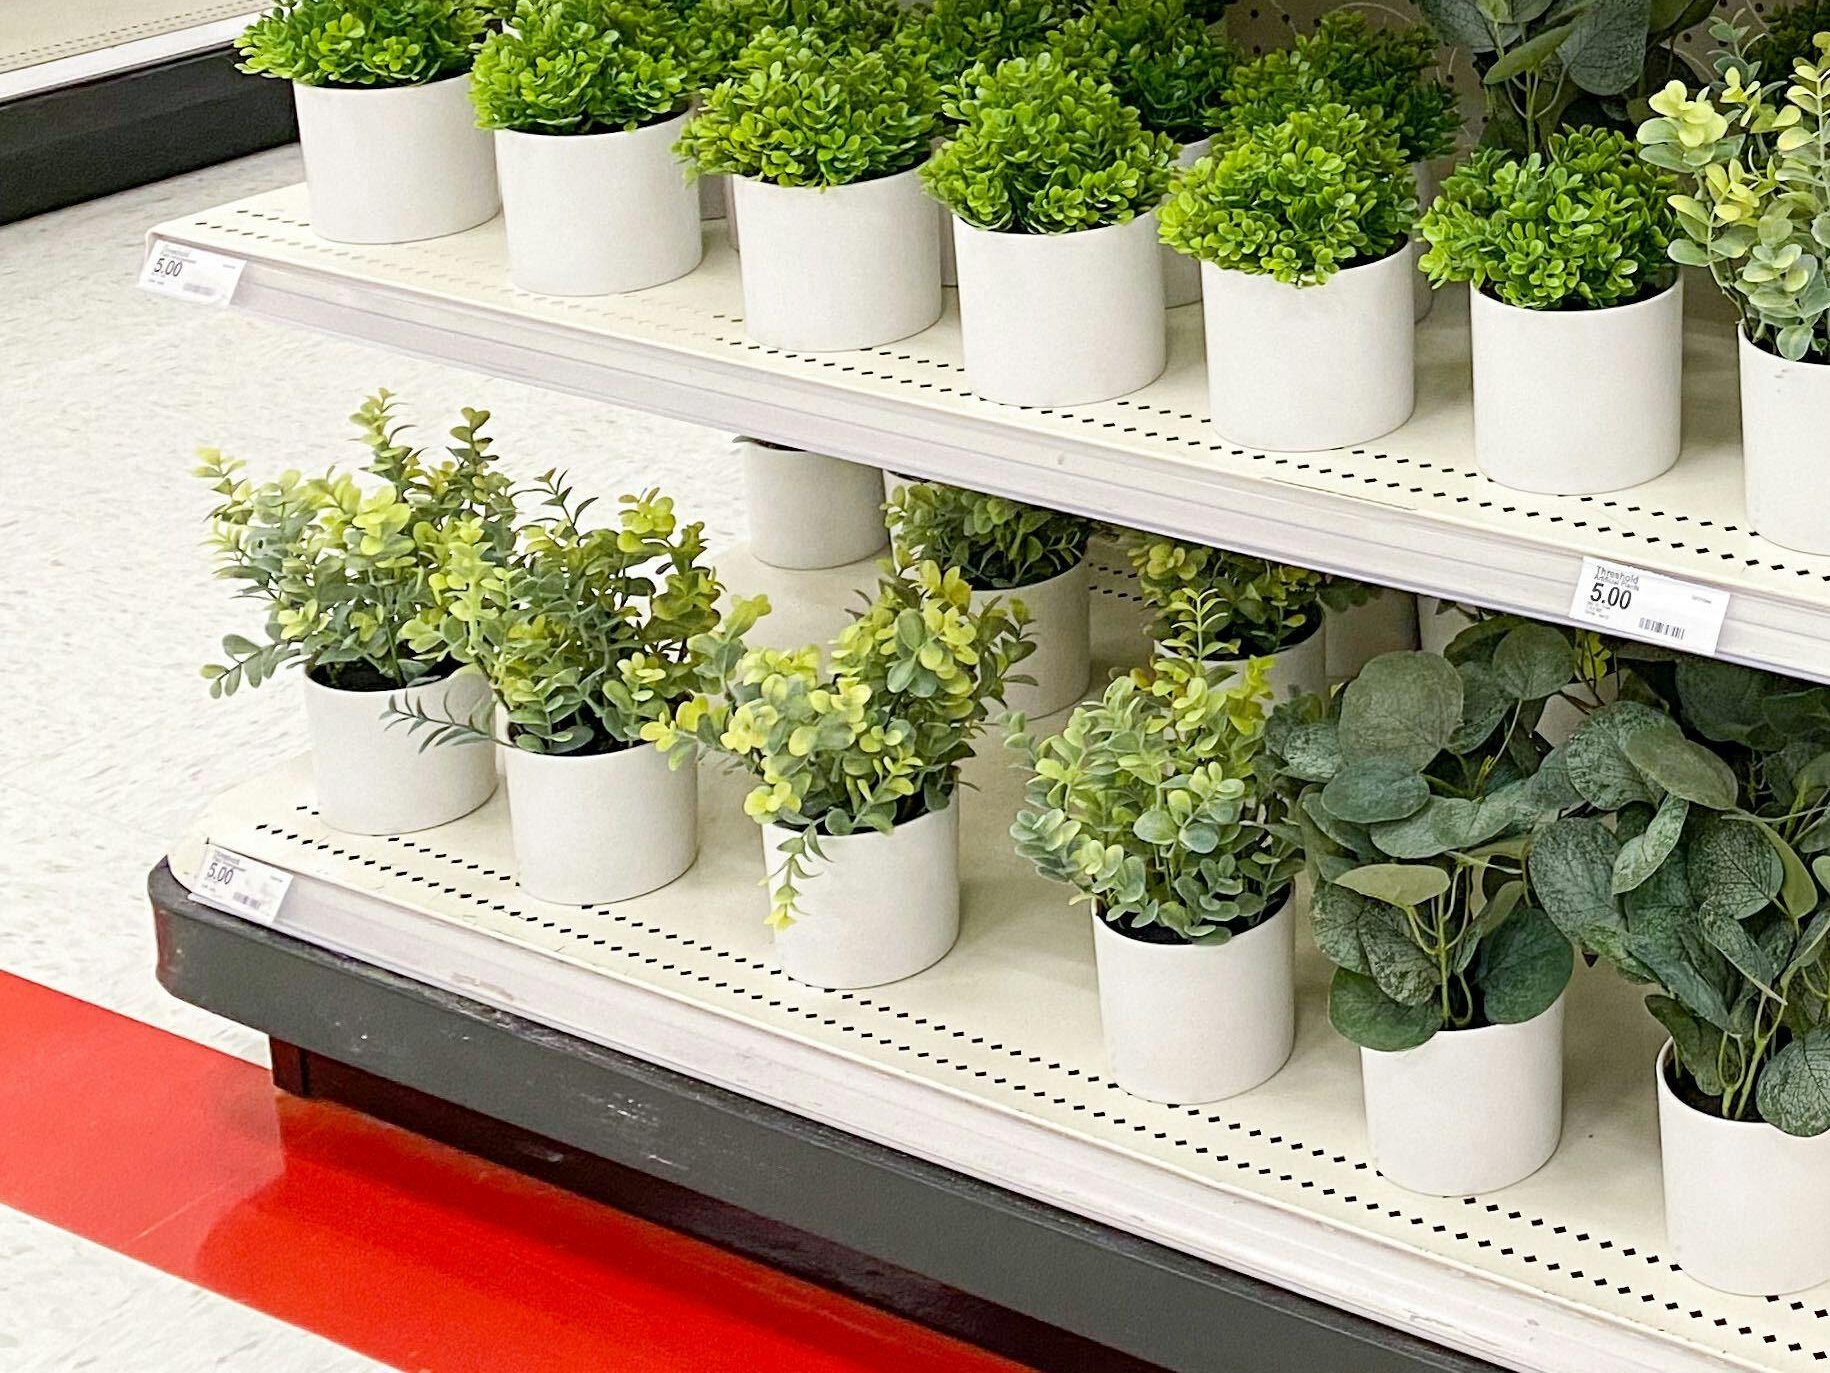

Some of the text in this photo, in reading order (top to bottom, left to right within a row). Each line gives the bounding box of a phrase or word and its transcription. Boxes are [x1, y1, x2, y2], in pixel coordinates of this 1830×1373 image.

[153, 258, 184, 277] 5.00
[1596, 565, 1640, 585] Threshold
[1590, 582, 1632, 610] 5.00
[207, 862, 234, 885] 5.00
